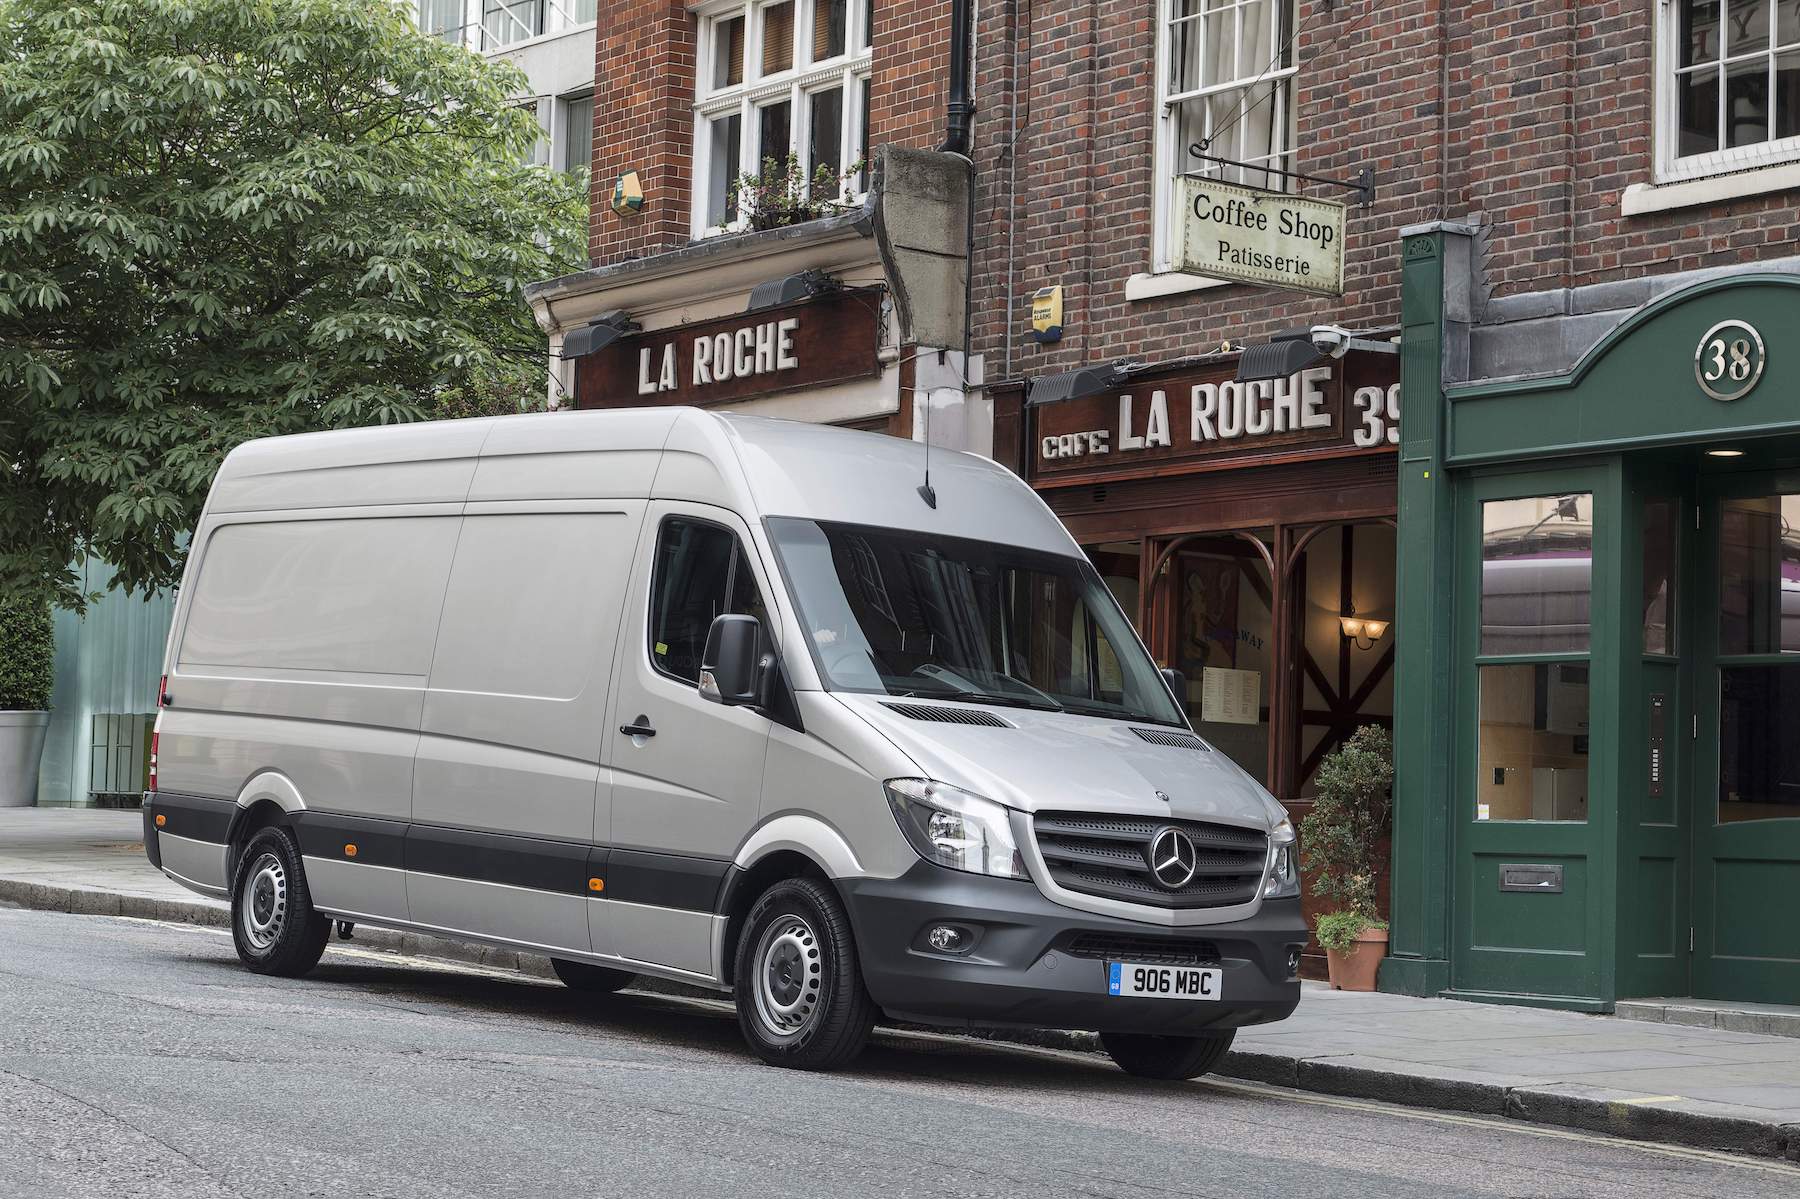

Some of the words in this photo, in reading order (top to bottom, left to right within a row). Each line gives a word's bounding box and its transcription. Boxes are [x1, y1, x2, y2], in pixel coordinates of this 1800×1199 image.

[1193, 193, 1268, 232] Coffee
[1278, 209, 1335, 249] Shop
[1217, 240, 1311, 276] Patisserie
[637, 343, 679, 395] LA
[692, 317, 800, 386] ROCHE
[1704, 338, 1751, 381] 38
[1041, 429, 1110, 460] CAFE
[1118, 390, 1172, 452] LA
[1190, 366, 1333, 442] ROCHE
[1133, 968, 1171, 993] 906
[1175, 970, 1212, 995] MBC
